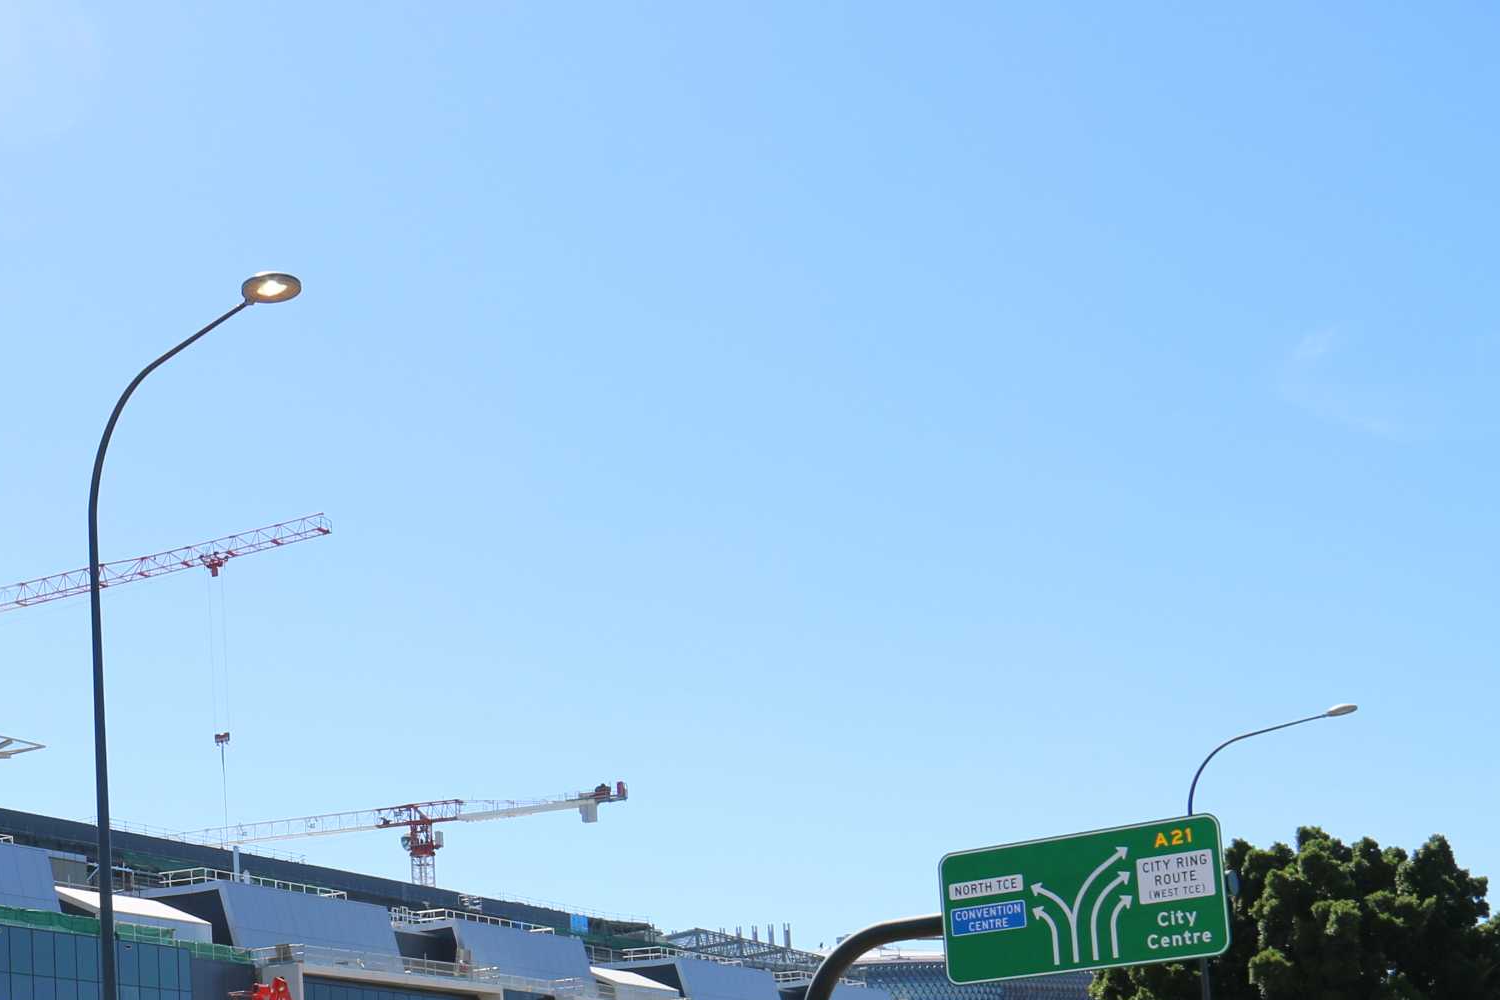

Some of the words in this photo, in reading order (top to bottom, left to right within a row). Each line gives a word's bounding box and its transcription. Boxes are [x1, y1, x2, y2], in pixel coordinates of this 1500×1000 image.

[1154, 827, 1192, 848] A21
[1142, 859, 1171, 873] CITY
[1176, 854, 1208, 868] RING
[955, 881, 992, 896] NORTH
[996, 878, 1017, 890] TCE
[1154, 870, 1197, 886] ROUTE
[1148, 887, 1178, 899] (WEST
[1182, 884, 1206, 895] TCE)
[955, 903, 1021, 921] CONVENTION
[1157, 910, 1197, 927] City
[968, 917, 1009, 931] CENTRE
[1147, 930, 1212, 949] Centre
